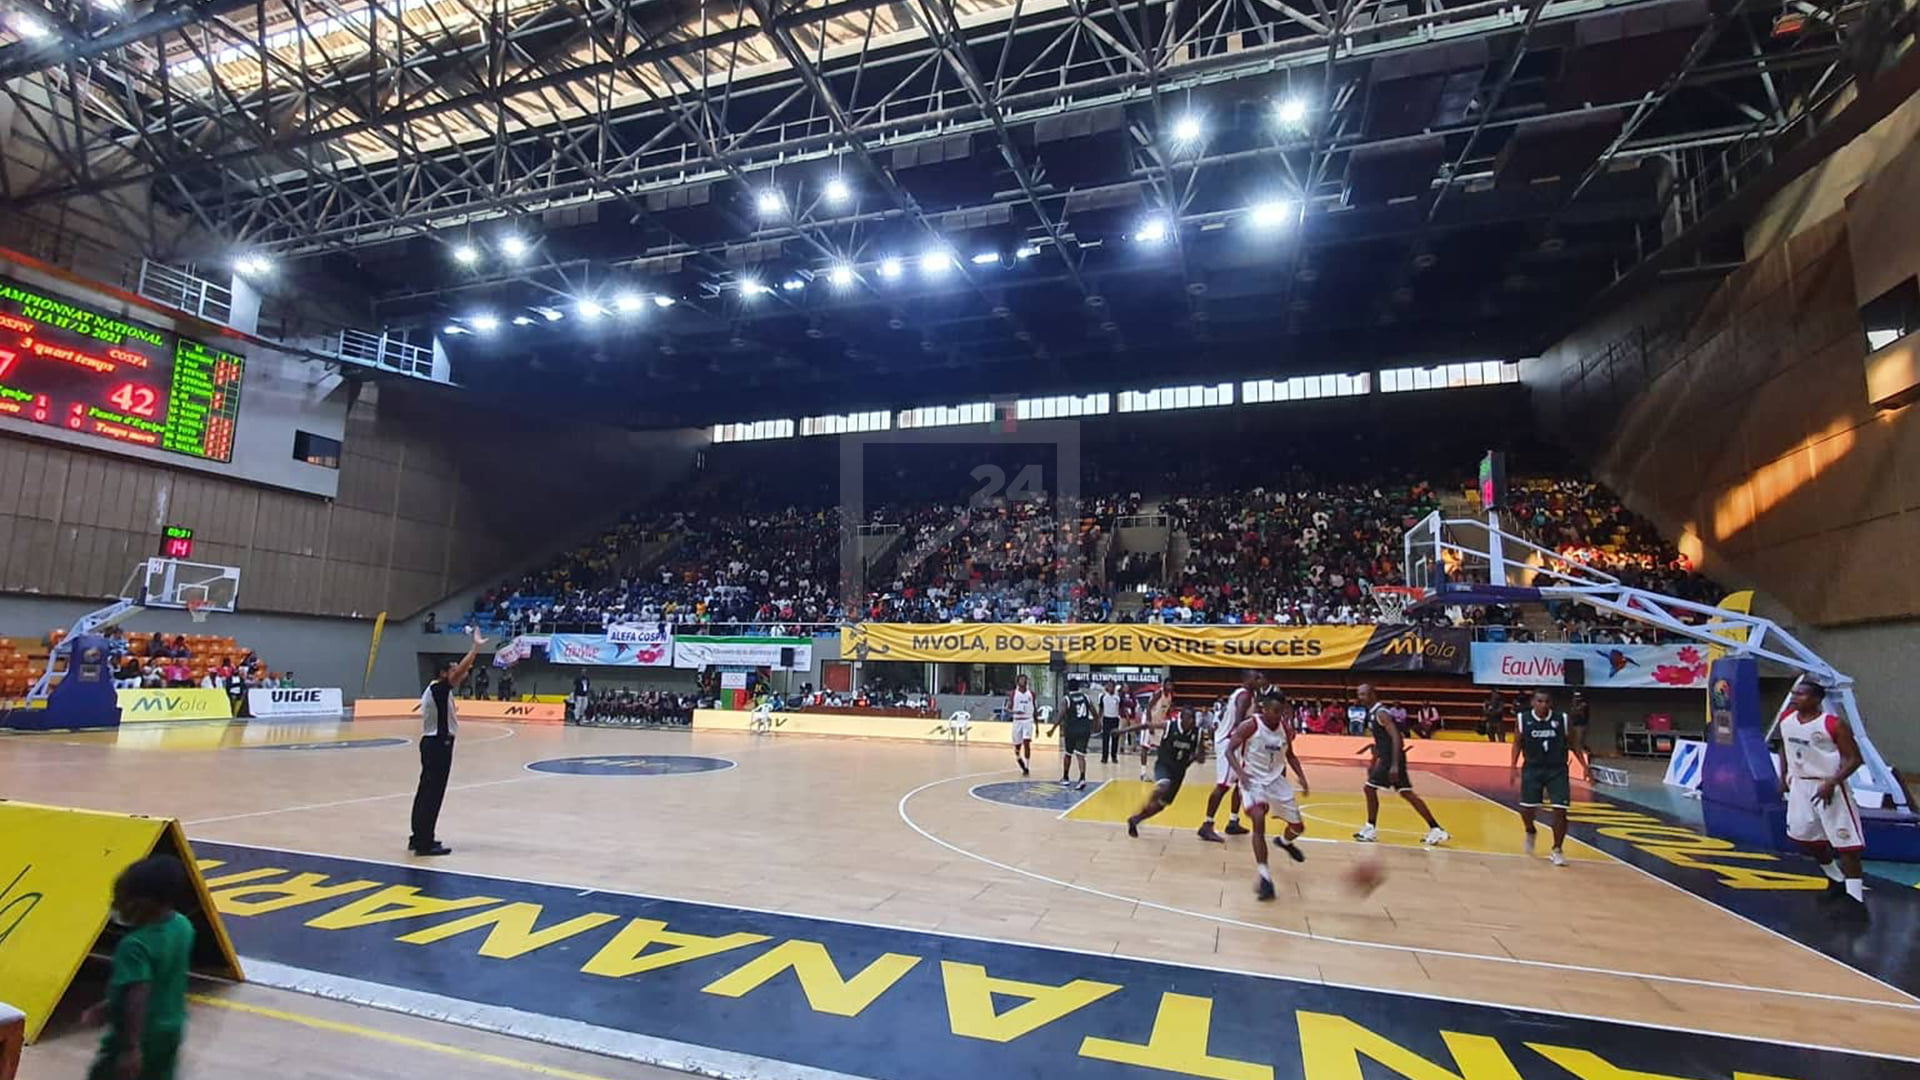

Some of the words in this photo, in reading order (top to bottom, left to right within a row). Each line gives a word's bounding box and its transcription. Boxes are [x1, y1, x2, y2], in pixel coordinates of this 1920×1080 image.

[92, 328, 122, 344] 2021
[94, 316, 163, 345] NATIONAL
[20, 337, 33, 348] 3
[111, 383, 155, 416] 42
[172, 541, 188, 556] 14
[611, 631, 636, 641] ALEFA
[913, 635, 989, 653] MVOLA,
[1103, 636, 1132, 651] DE
[1138, 636, 1215, 655] VOTRE
[1223, 636, 1321, 656] SUCCÈS
[1382, 637, 1456, 657] MVola
[131, 696, 207, 712] MVola
[271, 690, 322, 703] VIGIE
[504, 706, 535, 716] MV
[1542, 740, 1549, 752] 1
